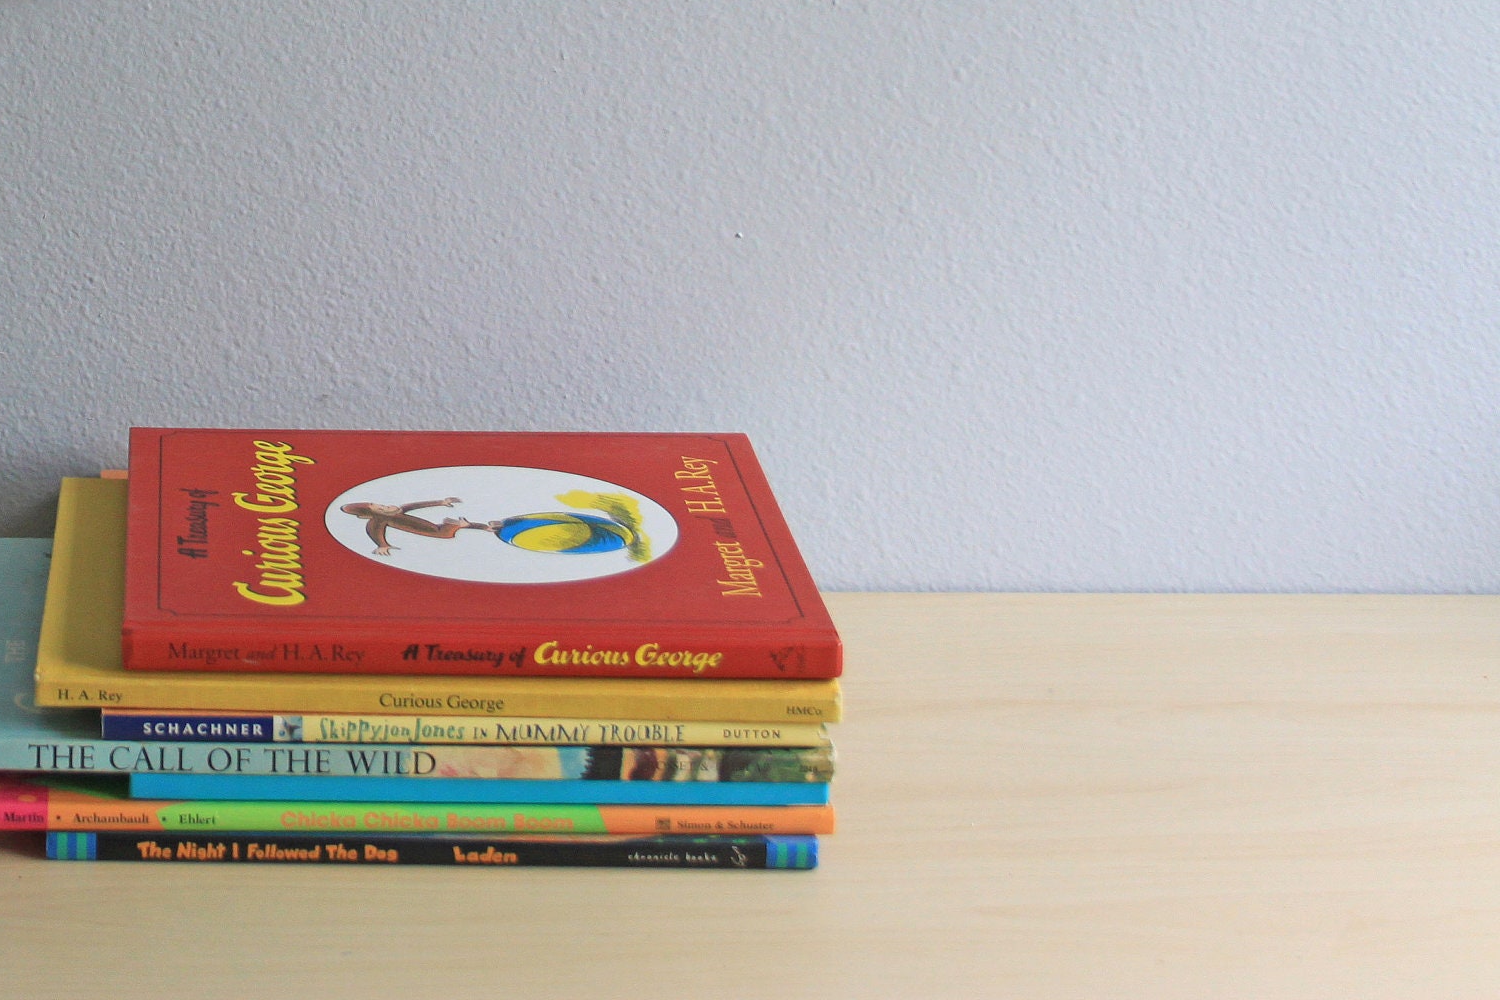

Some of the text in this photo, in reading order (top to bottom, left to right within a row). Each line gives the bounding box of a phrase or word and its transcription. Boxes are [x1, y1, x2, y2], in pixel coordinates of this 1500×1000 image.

[230, 440, 318, 607] Curious George
[713, 541, 764, 599] Margret
[168, 642, 240, 665] Margret
[246, 644, 277, 661] and
[402, 643, 420, 661] A
[424, 643, 504, 668] Treasury
[509, 646, 527, 668] of
[533, 639, 630, 666] Curious
[635, 642, 724, 674] George
[99, 689, 123, 703] Rey
[379, 692, 443, 709] Curious
[446, 694, 505, 713] George
[143, 722, 263, 736] SCHACHNER
[495, 722, 590, 742] MUMMY
[598, 722, 686, 743] TROUBLE
[723, 727, 781, 740] DUTTON
[28, 743, 95, 770] THE
[109, 745, 193, 772] CALL
[207, 746, 251, 773] OF
[263, 747, 331, 774] THE
[347, 749, 437, 777] WILD
[3, 810, 775, 831] Martin Archambault Ehlert Chicka Chicka Boom Boom Simon & Schuster
[137, 841, 172, 860] The
[176, 841, 227, 861] Night
[246, 843, 320, 861] Followed
[325, 844, 358, 861] The
[364, 844, 399, 863] Dog
[627, 852, 680, 862] chronicle
[685, 851, 718, 863] books
